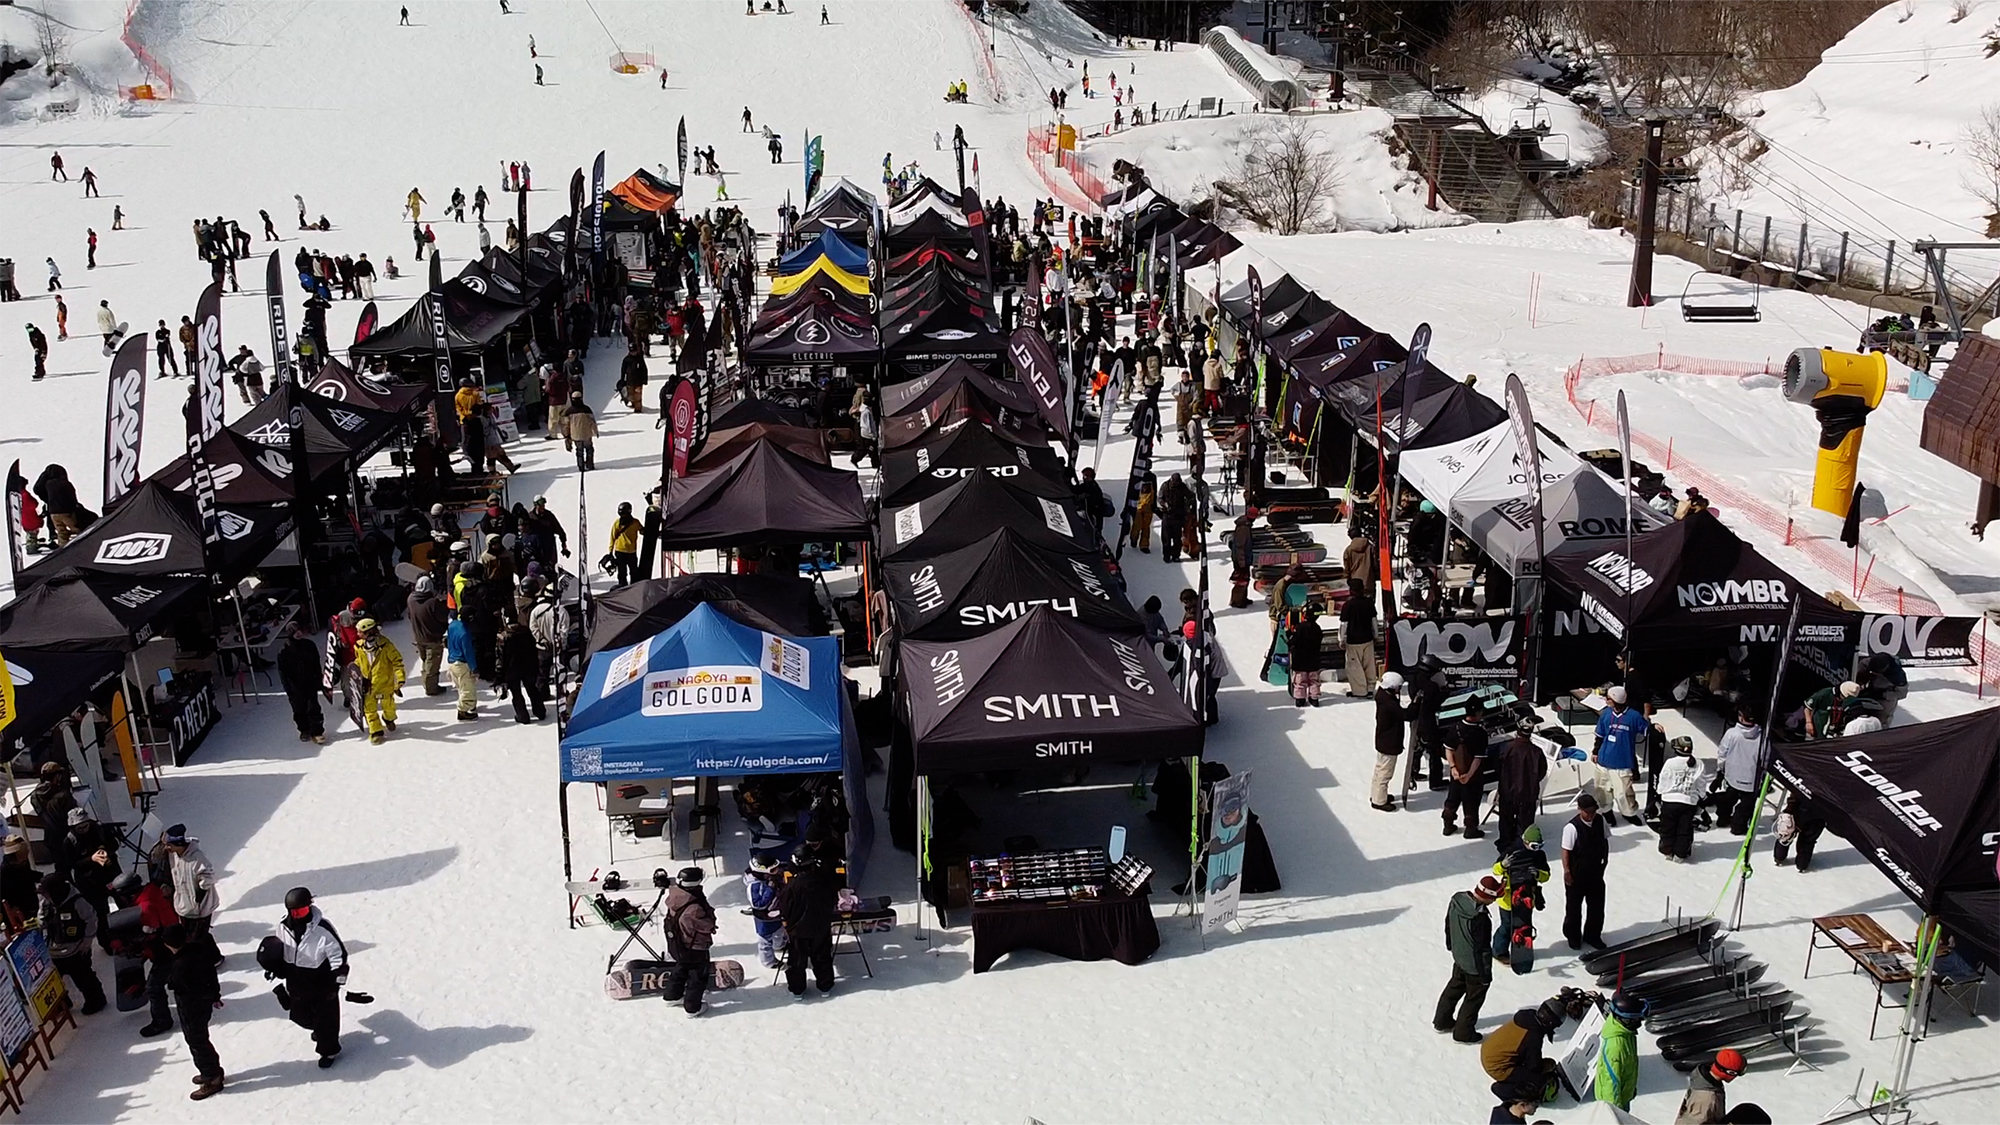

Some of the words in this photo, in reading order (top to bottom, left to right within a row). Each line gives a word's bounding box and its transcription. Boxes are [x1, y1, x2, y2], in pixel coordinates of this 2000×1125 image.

[272, 304, 287, 359] RIDE
[433, 301, 446, 349] RIDE
[792, 353, 834, 361] ELECTRIC
[1558, 518, 1652, 537] ROME
[105, 540, 161, 559] 100%
[909, 565, 944, 613] SMITH
[1067, 557, 1110, 600] SMITH
[1677, 580, 1790, 607] NOVMBR
[1110, 637, 1155, 695] SMITH
[1926, 647, 1965, 657] snow
[677, 674, 728, 685] NAGOYA
[930, 649, 965, 707] SMITH
[652, 686, 752, 708] GOLGODA
[984, 693, 1121, 723] SMITH
[696, 754, 829, 770] https://golgoda.com/
[1036, 740, 1093, 757] SMITH
[1773, 759, 1813, 796] Scooter
[1834, 750, 1943, 831] Scooter
[1875, 848, 1925, 894] Scooter
[1208, 908, 1234, 928] SMITH
